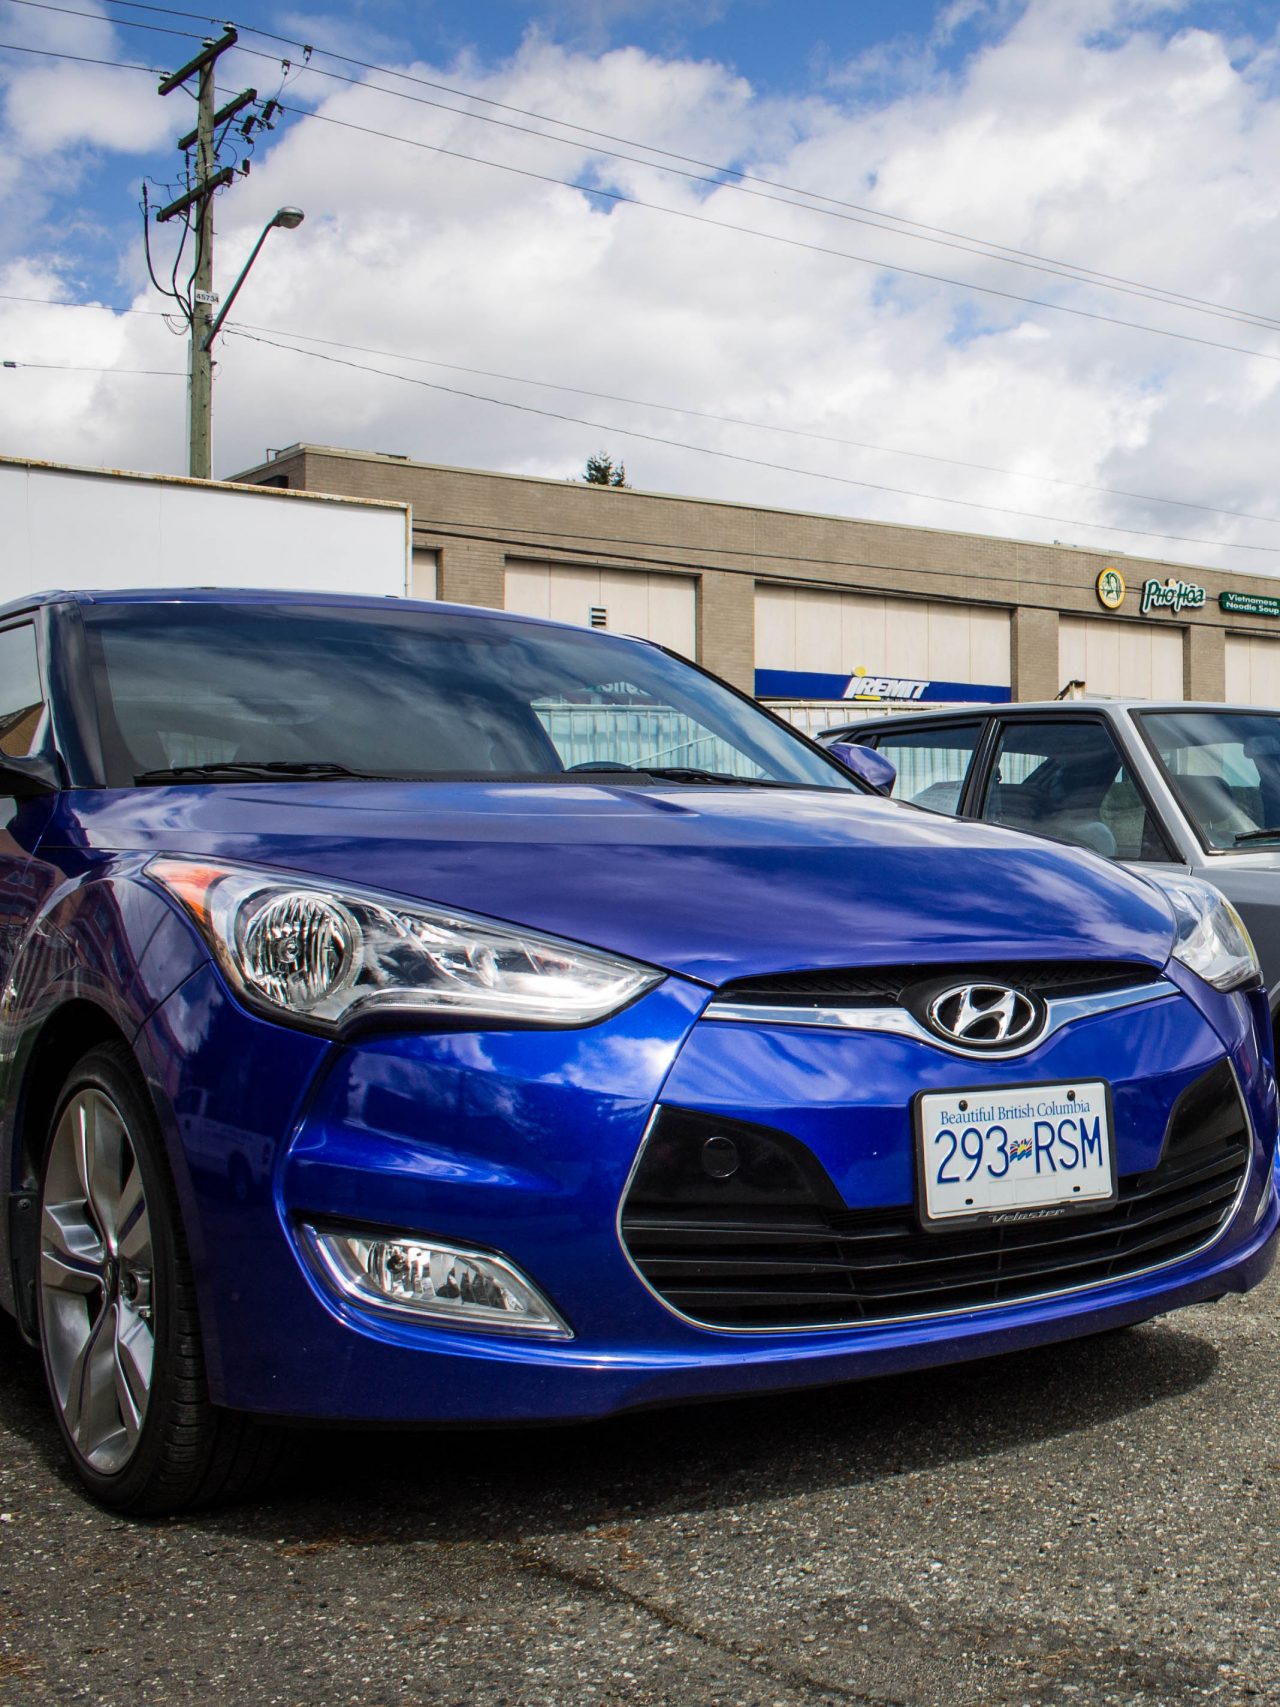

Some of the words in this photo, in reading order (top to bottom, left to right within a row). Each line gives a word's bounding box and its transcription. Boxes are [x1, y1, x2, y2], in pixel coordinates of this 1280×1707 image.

[1226, 601, 1257, 611] Noodle
[1258, 604, 1280, 615] Soup
[1228, 593, 1278, 606] Vietnamese
[941, 1107, 995, 1125] Beautiful
[998, 1104, 1035, 1121] British
[1037, 1099, 1091, 1117] Columbia
[934, 1124, 1010, 1184] 293
[1033, 1115, 1103, 1174] RSM
